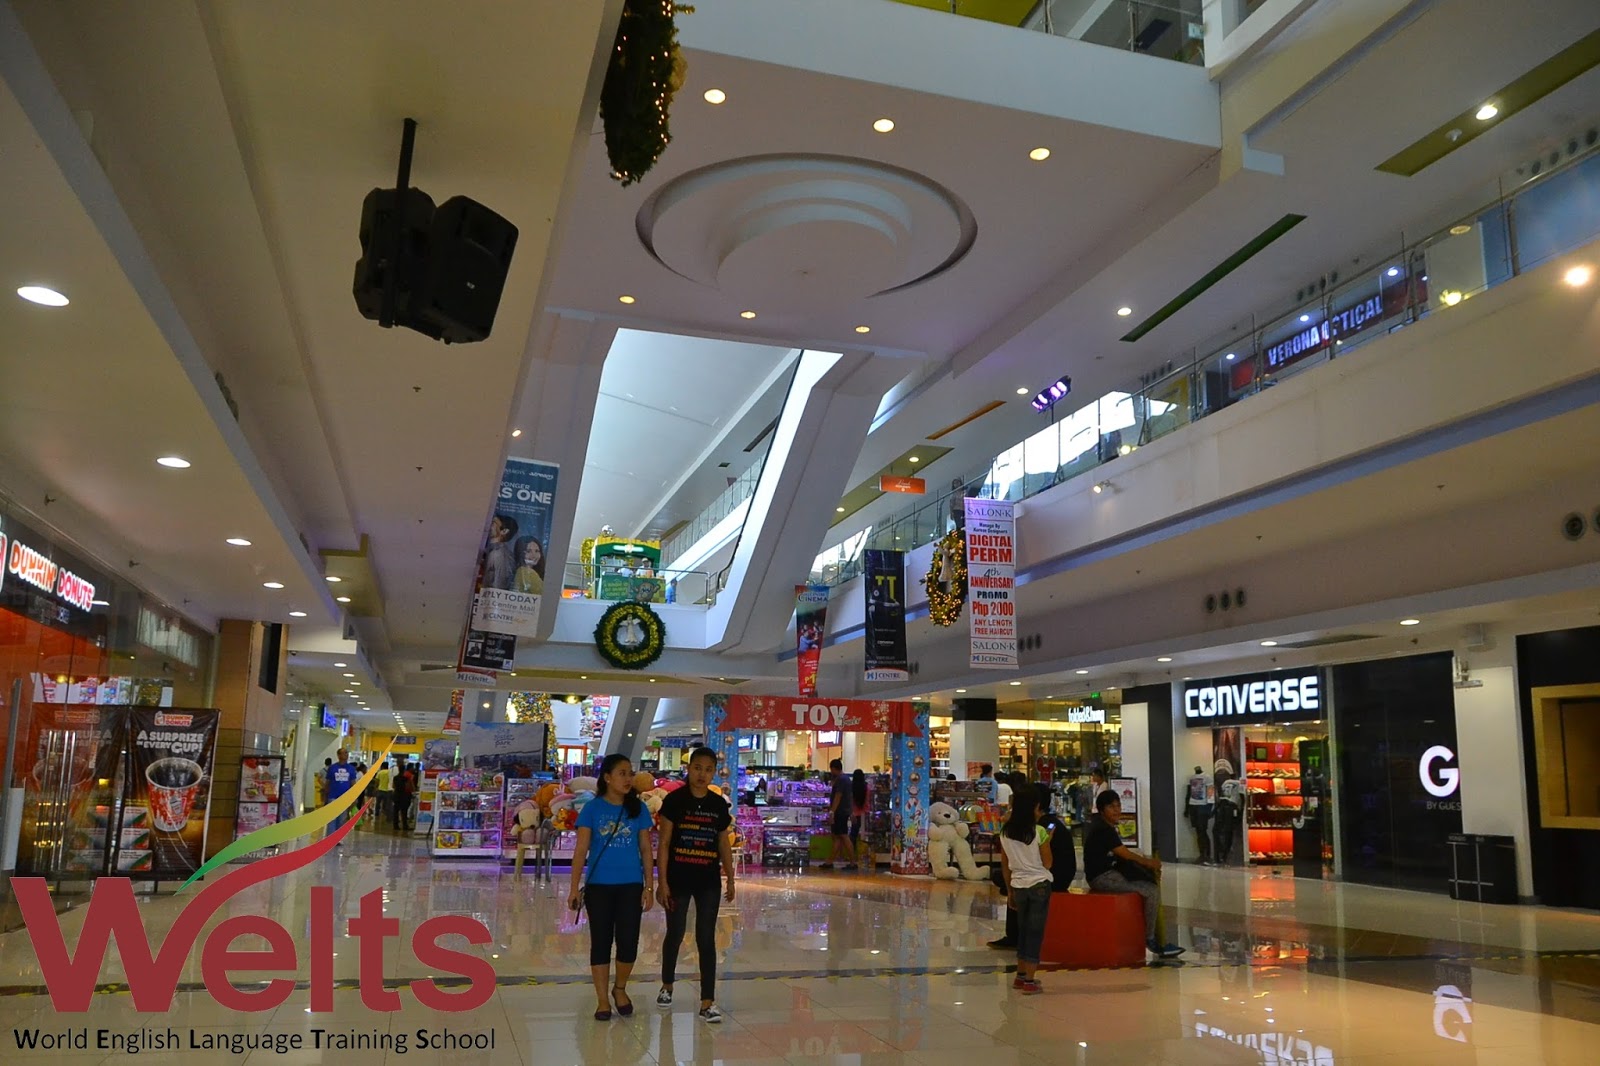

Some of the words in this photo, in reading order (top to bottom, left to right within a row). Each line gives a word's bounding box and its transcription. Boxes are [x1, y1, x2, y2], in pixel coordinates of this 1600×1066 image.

[1268, 326, 1320, 366] VERONA
[498, 487, 513, 499] S
[517, 489, 552, 504] ONE
[969, 534, 1012, 548] DIGITAL
[969, 547, 1012, 563] PERM
[57, 567, 95, 612] DONUTS
[970, 576, 1014, 589] ANNIVERSARY
[505, 593, 538, 604] TODAY
[977, 590, 1008, 599] PROMO
[972, 601, 989, 616] Php
[990, 601, 1014, 616] 2000
[974, 618, 987, 626] ANY
[988, 619, 1013, 627] LENGTH
[974, 627, 988, 635] FREE
[1184, 675, 1319, 718] CONVERSE
[791, 703, 848, 727] TOY
[137, 730, 148, 740] A
[149, 731, 204, 743] SURPRIZE
[143, 740, 171, 749] EVERY
[1419, 745, 1459, 797] G
[1426, 801, 1437, 810] BY
[1438, 801, 1462, 811] GUES
